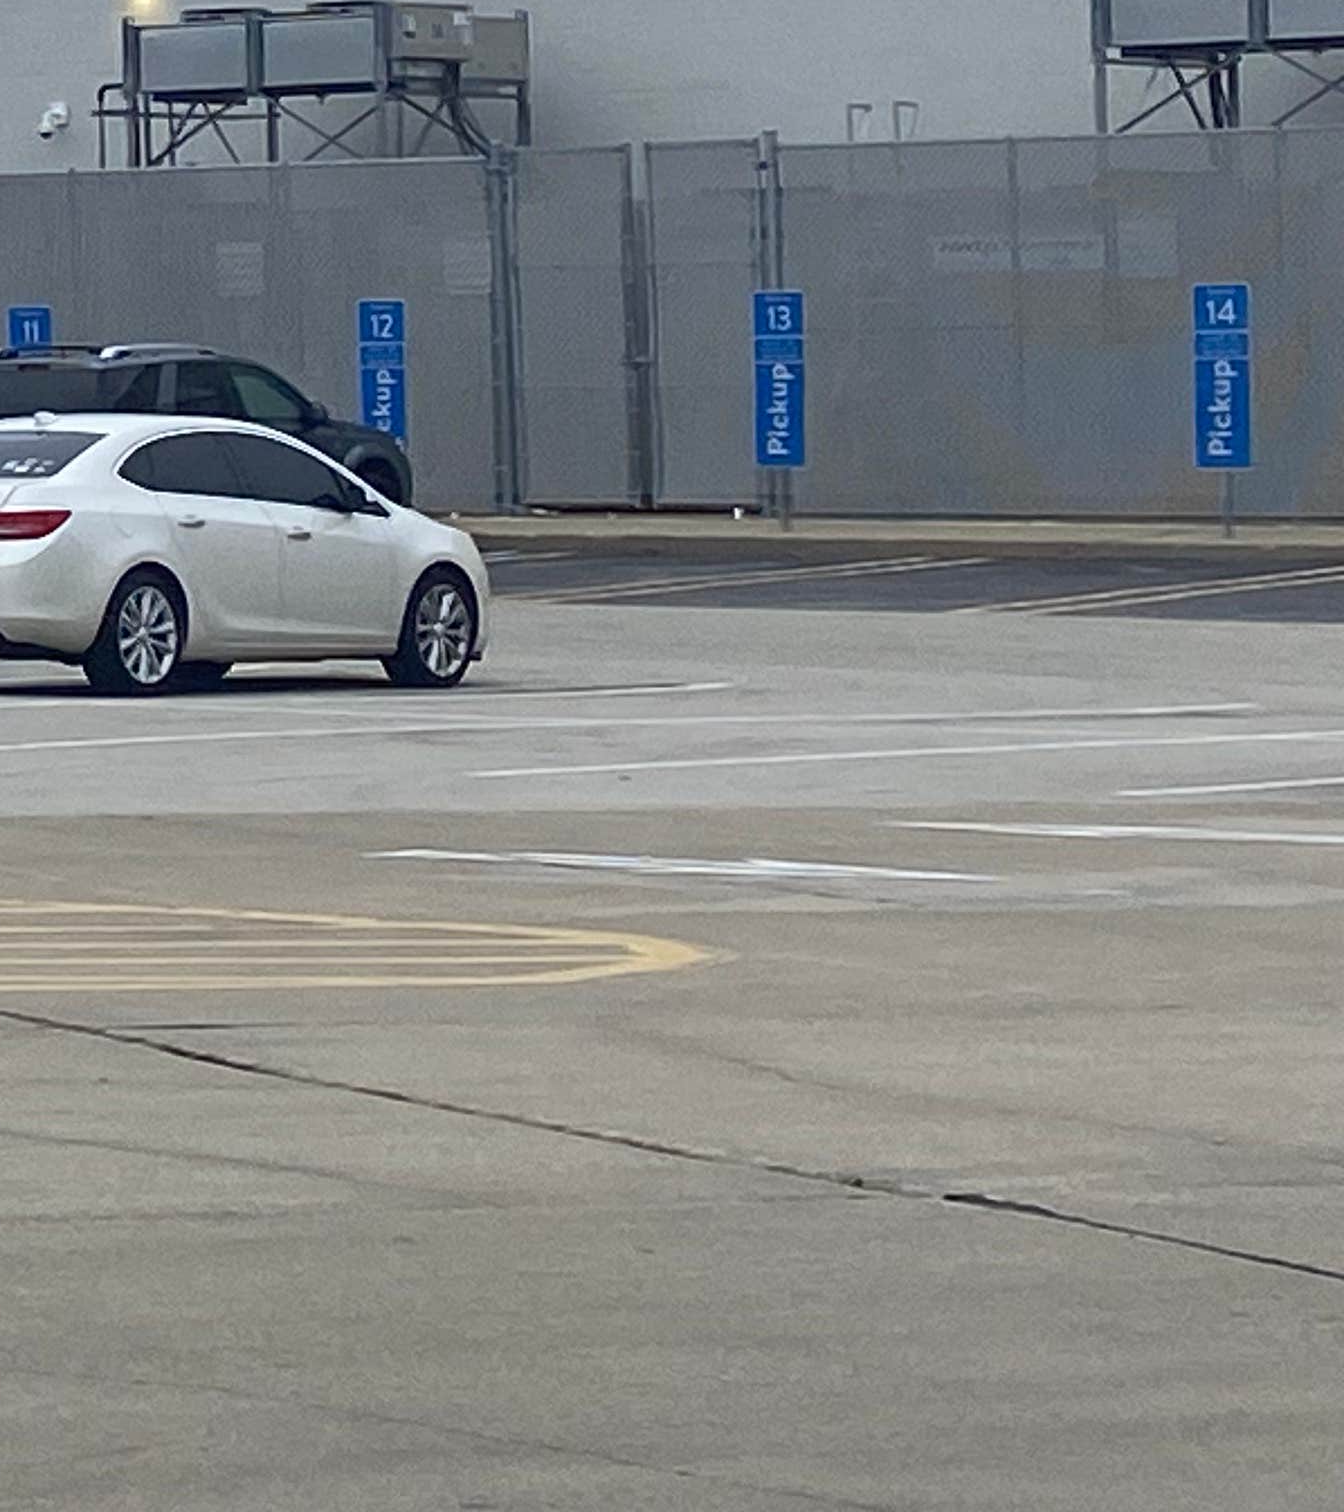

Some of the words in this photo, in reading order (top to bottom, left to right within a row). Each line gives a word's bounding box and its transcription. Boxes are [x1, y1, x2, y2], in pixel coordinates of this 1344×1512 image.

[767, 305, 792, 331] 13
[1206, 298, 1236, 325] 14
[23, 319, 39, 343] 11
[370, 313, 394, 338] 12
[371, 369, 398, 432] ckup
[766, 362, 795, 455] Pickup
[1207, 359, 1239, 456] Pickup
